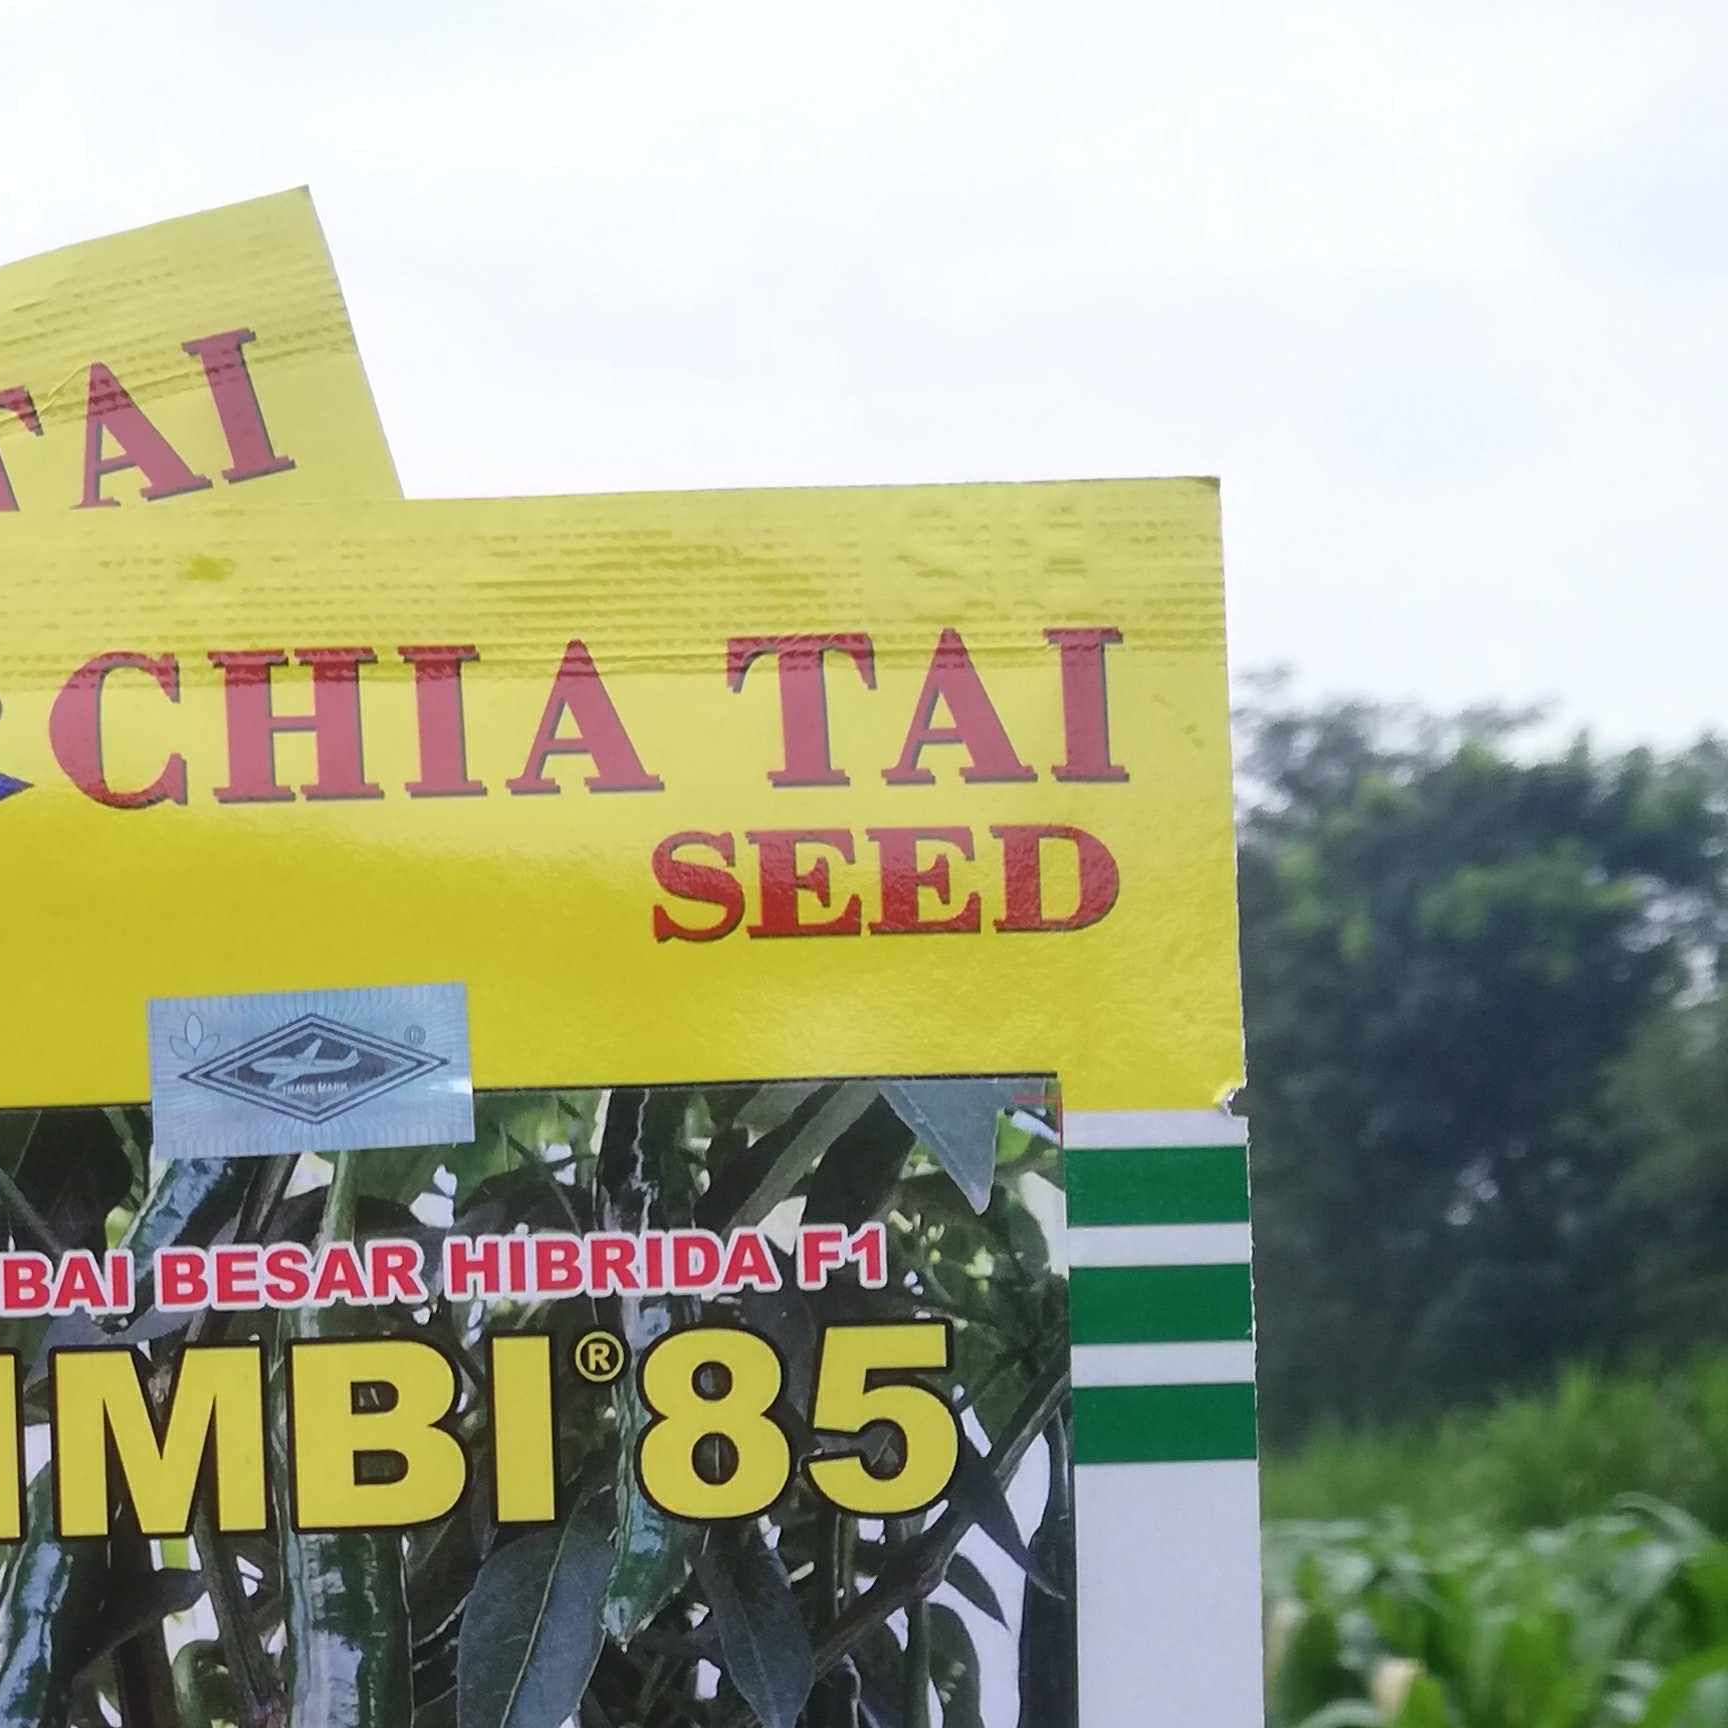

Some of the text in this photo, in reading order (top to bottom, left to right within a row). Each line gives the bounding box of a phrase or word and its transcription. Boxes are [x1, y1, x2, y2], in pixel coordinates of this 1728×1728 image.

[48, 626, 1130, 808] CHIA TAI
[650, 824, 1120, 941] SEED
[156, 1241, 428, 1310] BESAR
[442, 1228, 782, 1300] HIBRIDA
[795, 1222, 888, 1291] F1
[636, 1320, 964, 1523] 85
